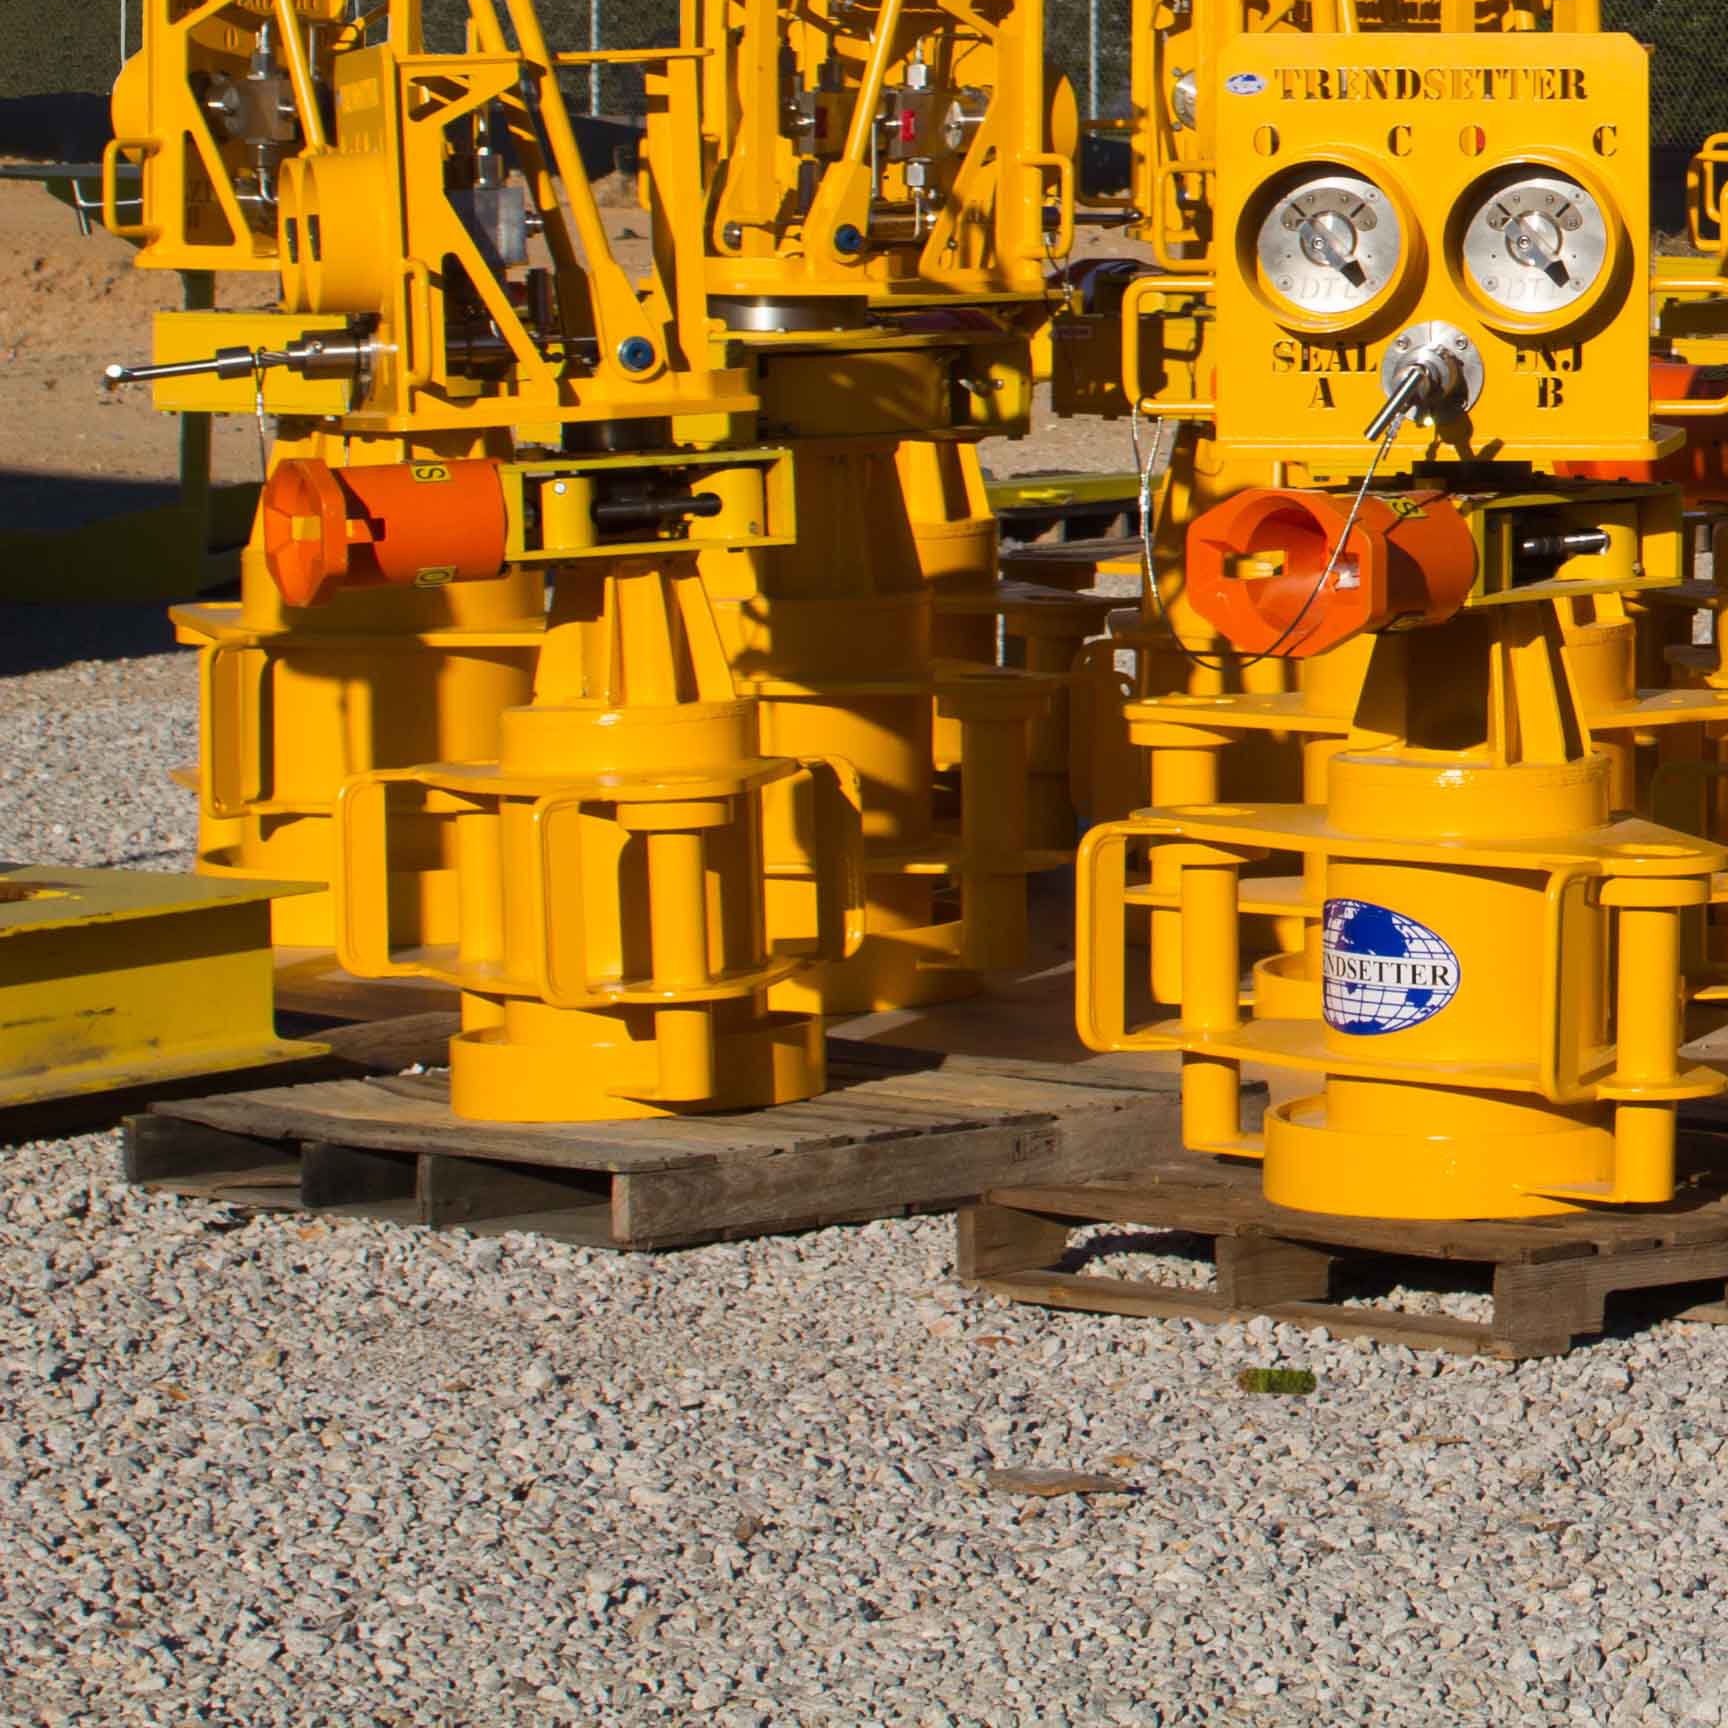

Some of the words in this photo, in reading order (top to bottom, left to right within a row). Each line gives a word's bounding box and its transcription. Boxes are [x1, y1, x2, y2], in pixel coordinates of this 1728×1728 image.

[1273, 68, 1588, 101] TRENDSETTER
[1253, 125, 1280, 157] O
[1387, 125, 1413, 157] C
[1459, 125, 1486, 157] O
[1592, 125, 1618, 157] C
[1272, 340, 1377, 373] SEAL
[1308, 377, 1336, 408] A
[1536, 377, 1564, 408] B
